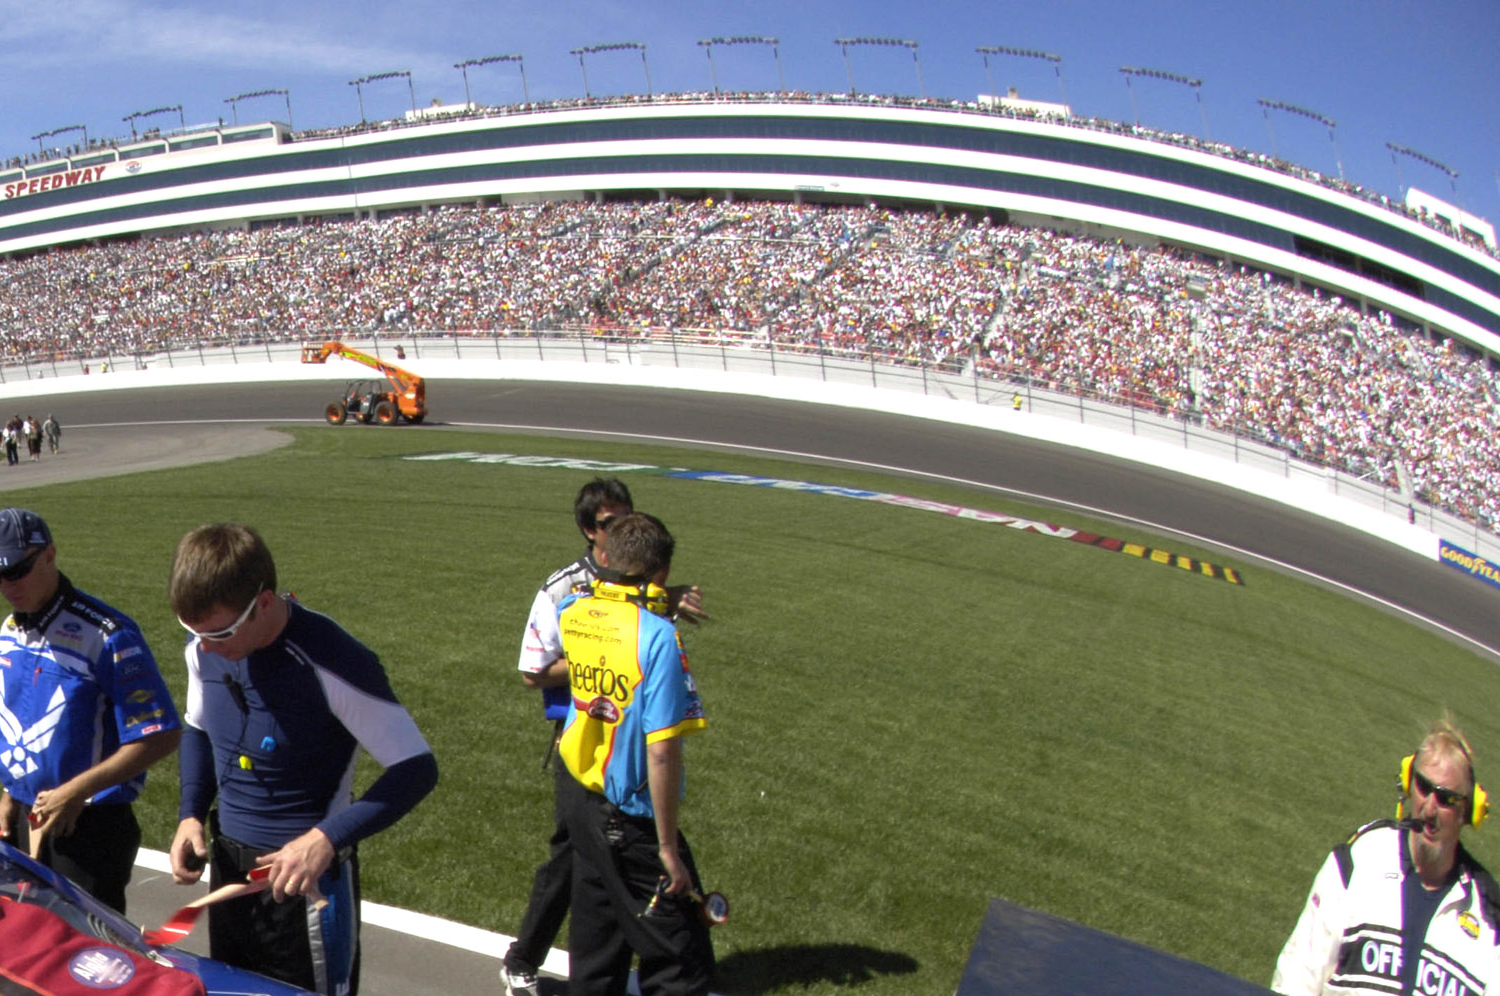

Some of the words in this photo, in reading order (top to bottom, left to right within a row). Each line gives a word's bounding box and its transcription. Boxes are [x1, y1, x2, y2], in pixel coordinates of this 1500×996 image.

[5, 165, 106, 200] SPEEDWAY
[1441, 546, 1500, 584] GOODYEA
[566, 651, 629, 702] heerios
